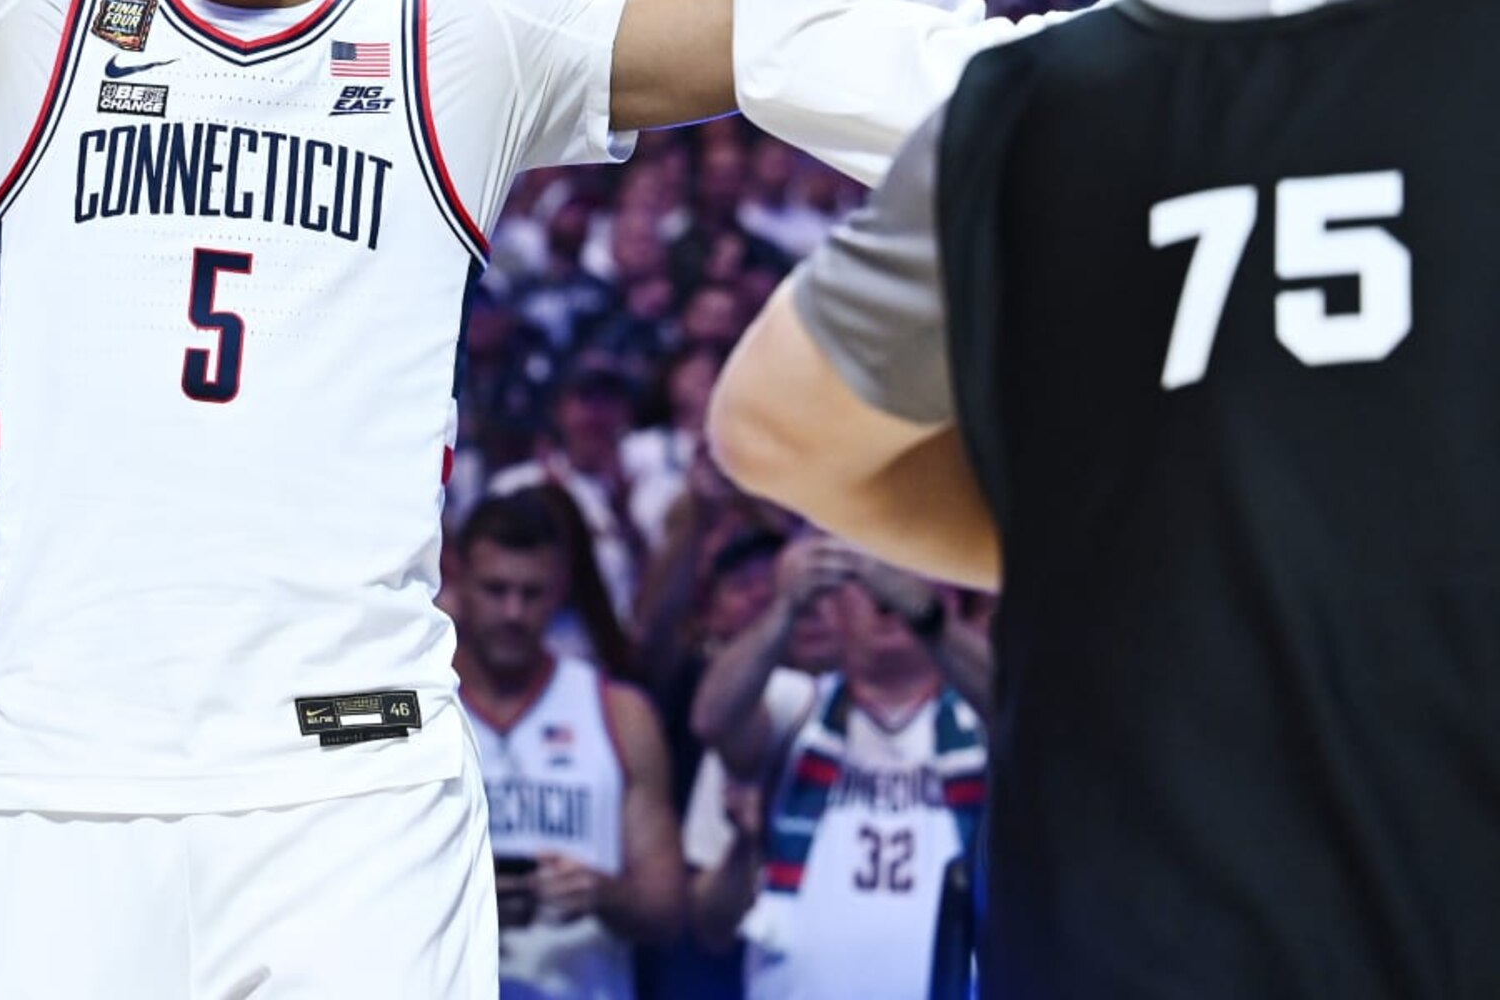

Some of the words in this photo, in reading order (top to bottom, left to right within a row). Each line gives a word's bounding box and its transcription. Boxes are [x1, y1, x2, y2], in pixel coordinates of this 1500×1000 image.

[107, 1, 145, 16] FINAL
[102, 12, 141, 28] FOUR
[115, 84, 145, 101] BE
[340, 86, 384, 99] BIG
[100, 98, 163, 113] CHANGE
[333, 98, 395, 111] EAST
[74, 122, 393, 250] CONNECTICUT
[1148, 168, 1412, 391] 75
[181, 247, 253, 403] 5
[390, 702, 410, 716] 46
[854, 823, 915, 894] 32
